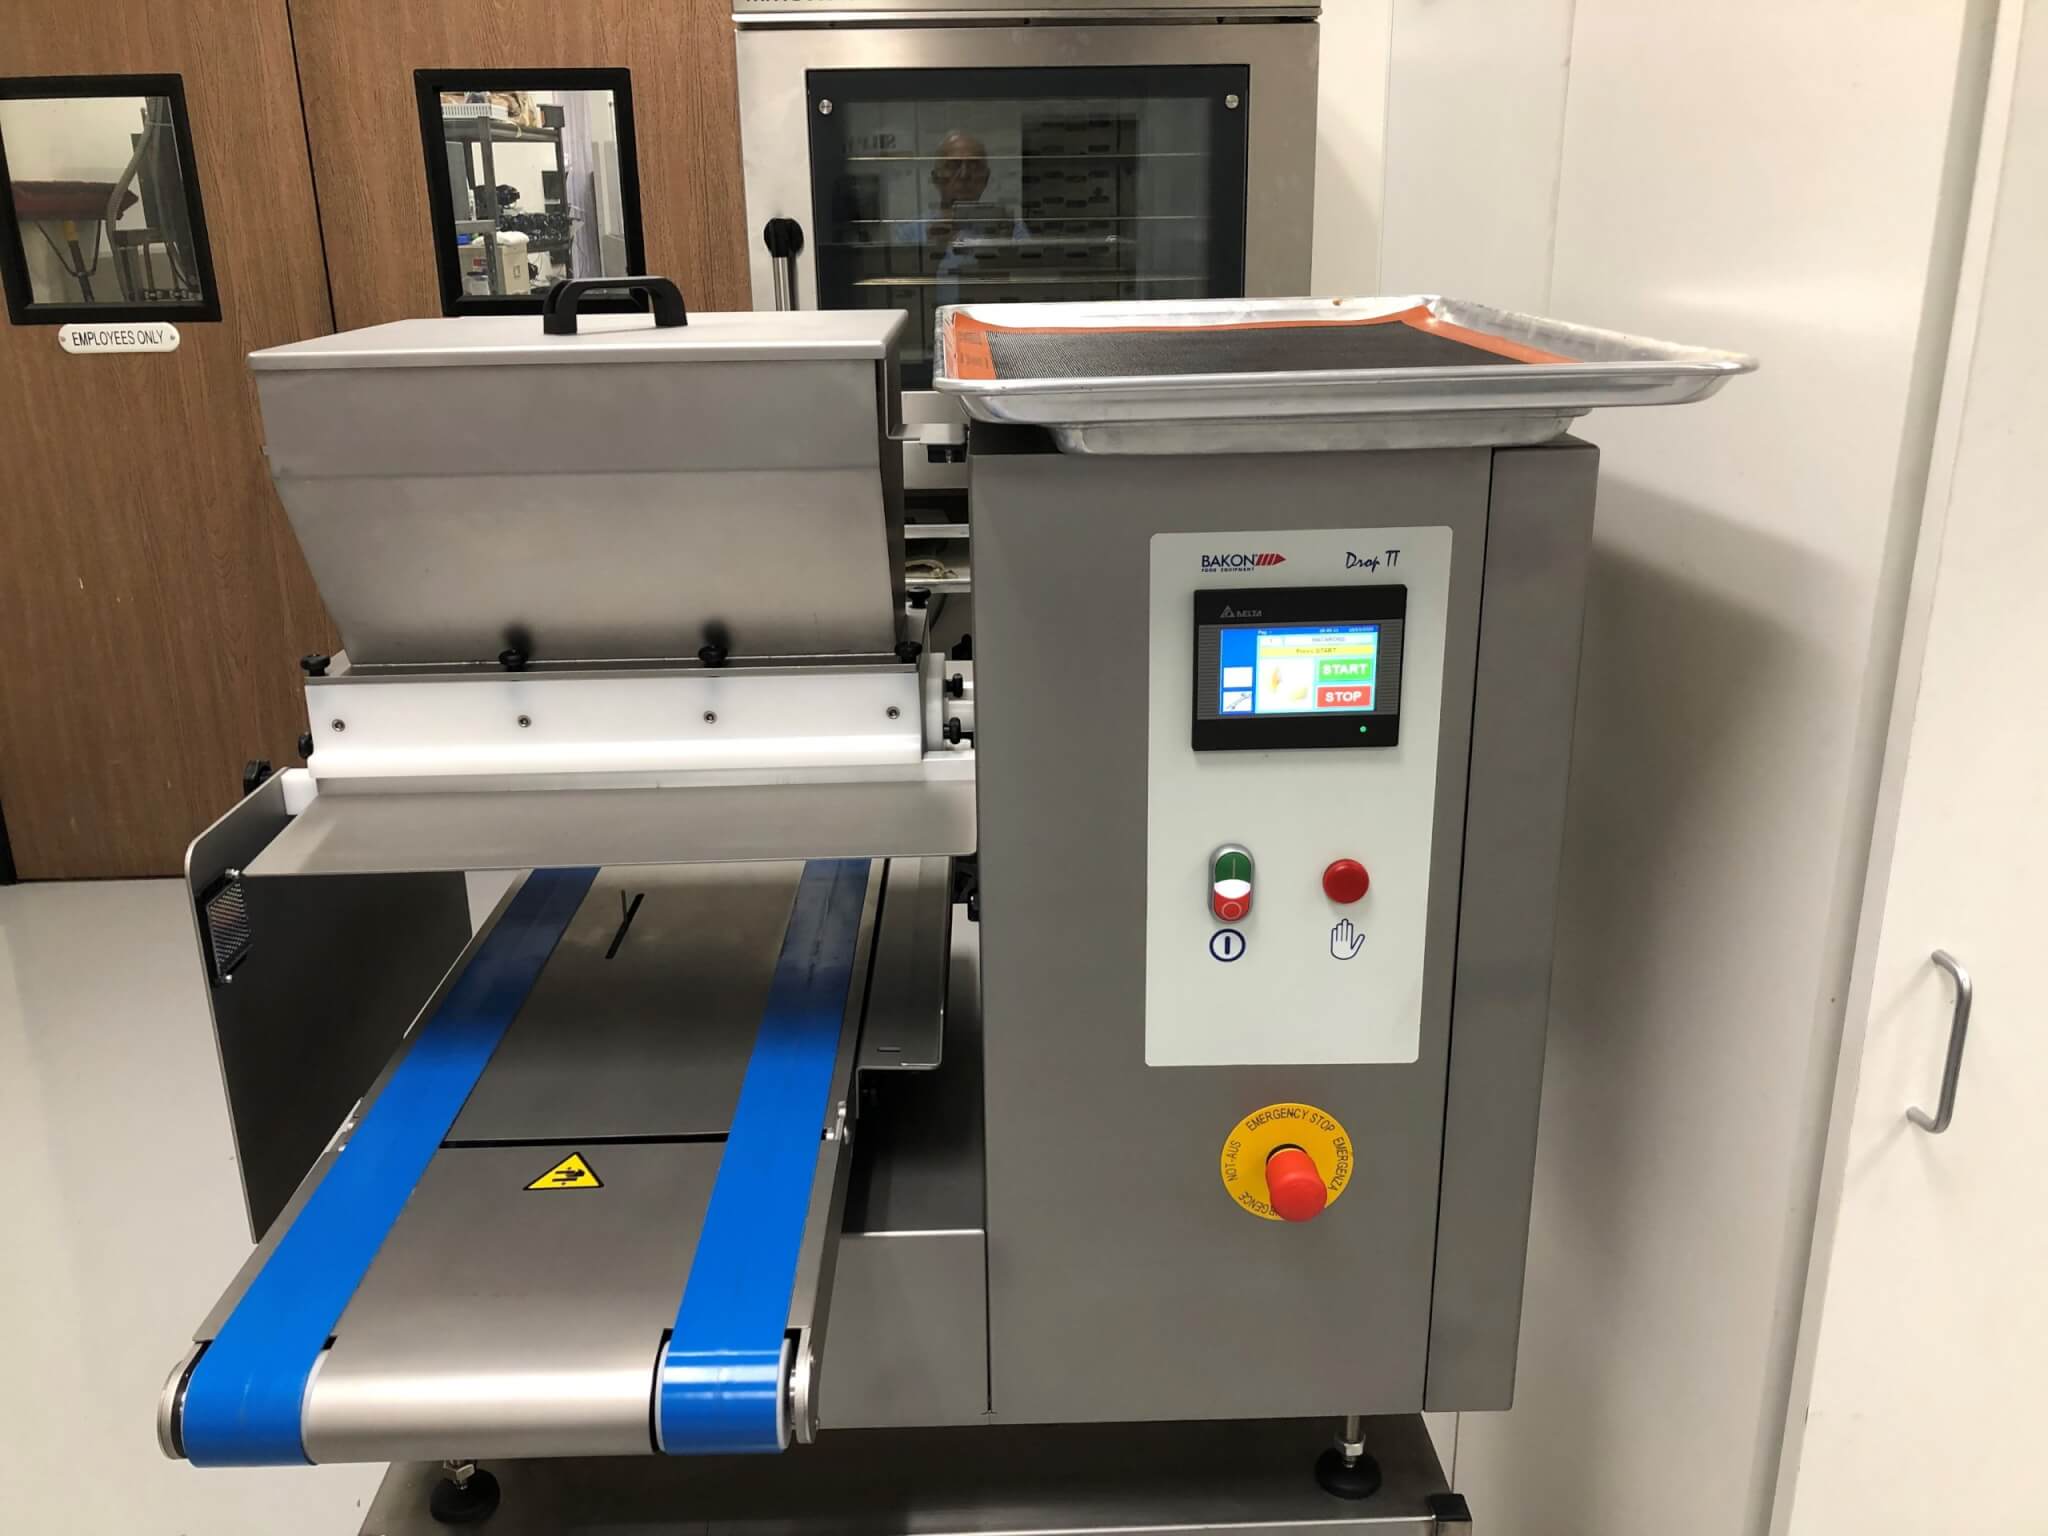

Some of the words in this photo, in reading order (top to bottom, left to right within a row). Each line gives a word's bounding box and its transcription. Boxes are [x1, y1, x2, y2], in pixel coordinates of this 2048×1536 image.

[72, 330, 135, 346] EMPLOYEES
[137, 329, 163, 345] ONLY
[1201, 553, 1255, 568] BAKON
[1345, 551, 1380, 573] Drop
[1236, 609, 1263, 618] DELTA
[1322, 662, 1368, 676] START
[1325, 690, 1363, 703] STOP
[1246, 1107, 1309, 1132] EMERGENCY
[1309, 1112, 1336, 1133] STOP
[1224, 1140, 1242, 1182] NOT-AUS
[1327, 1136, 1349, 1192] EMERGENZA
